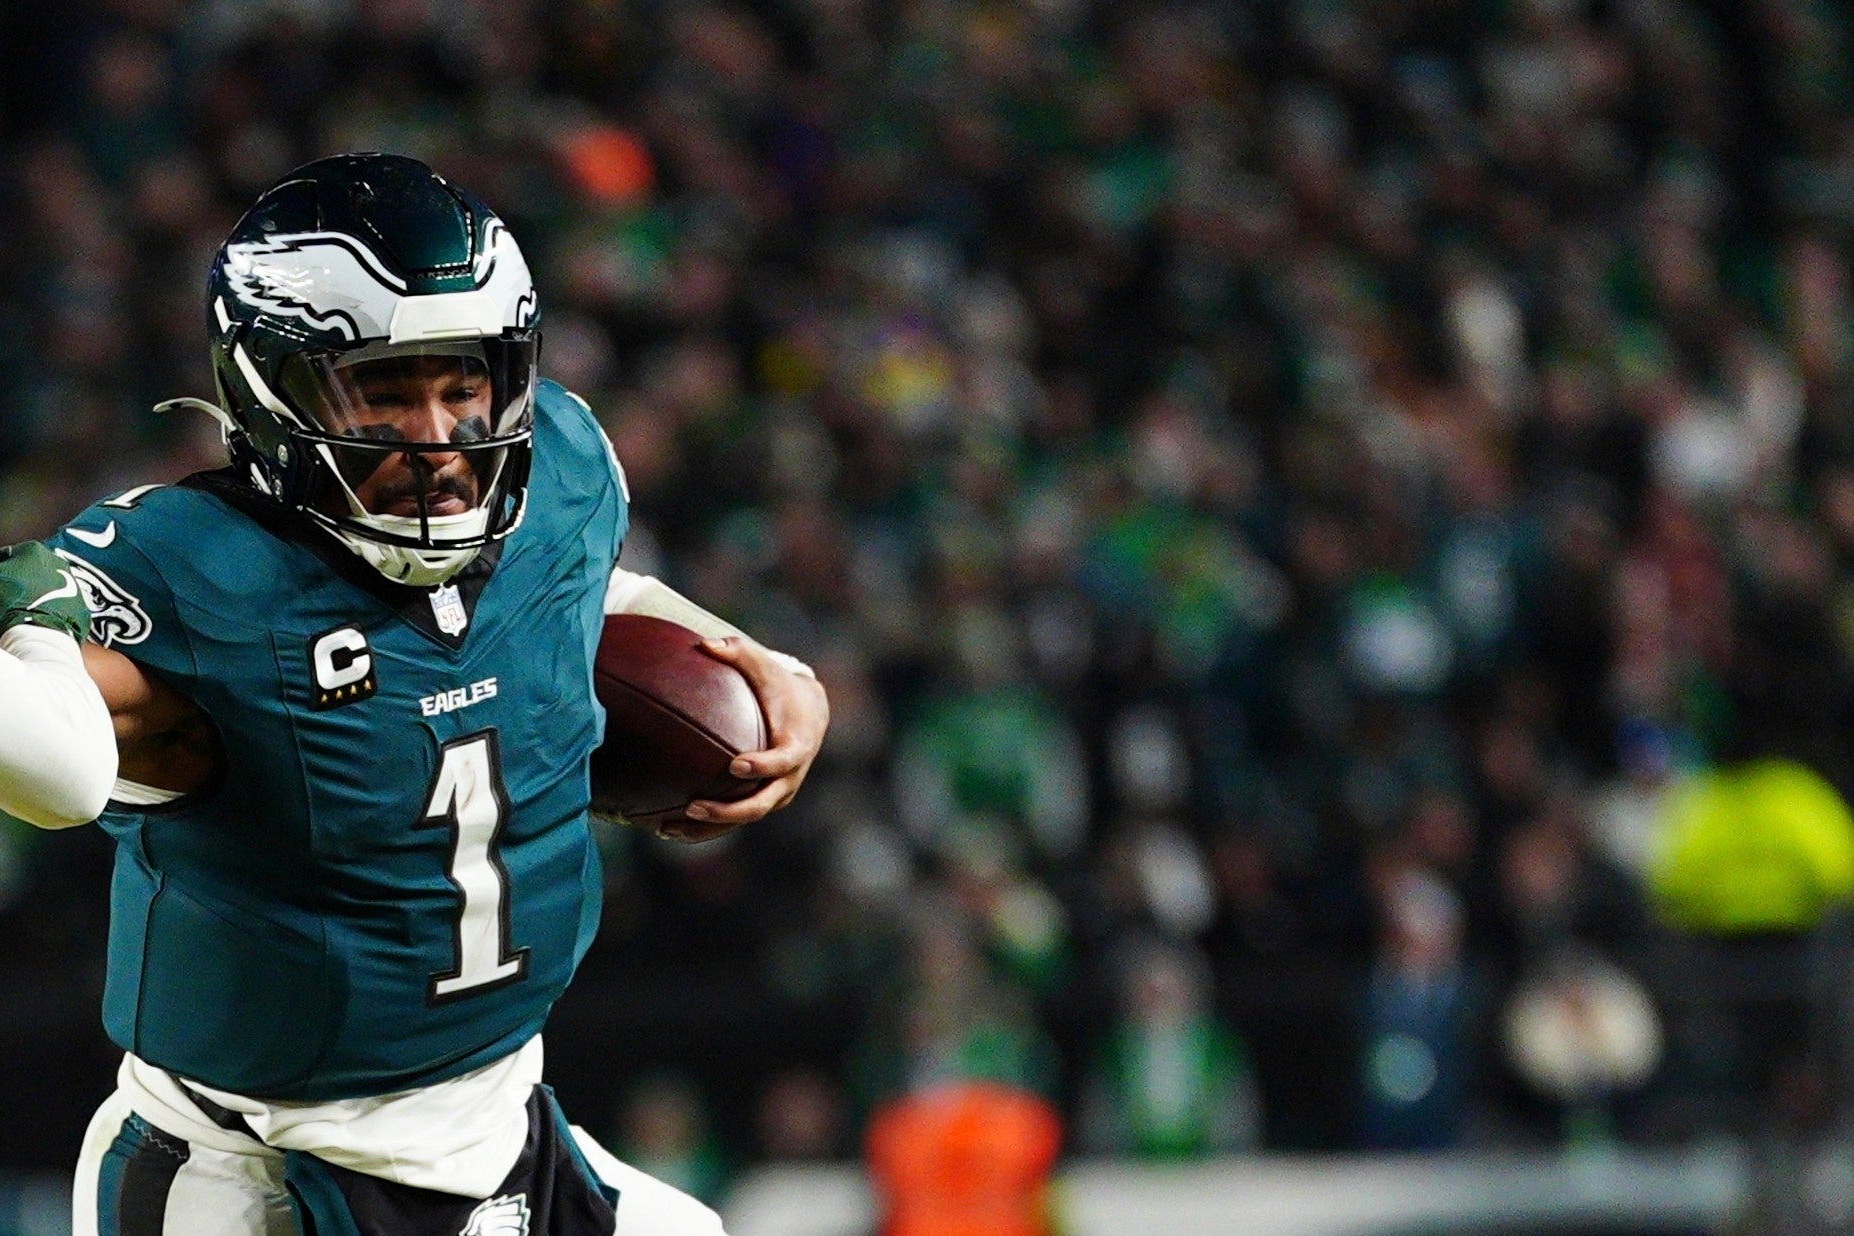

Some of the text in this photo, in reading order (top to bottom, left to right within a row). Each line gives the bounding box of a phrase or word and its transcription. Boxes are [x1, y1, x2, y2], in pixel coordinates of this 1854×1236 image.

[313, 627, 371, 691] C
[418, 676, 498, 717] EAGLES
[421, 731, 526, 1002] 1
